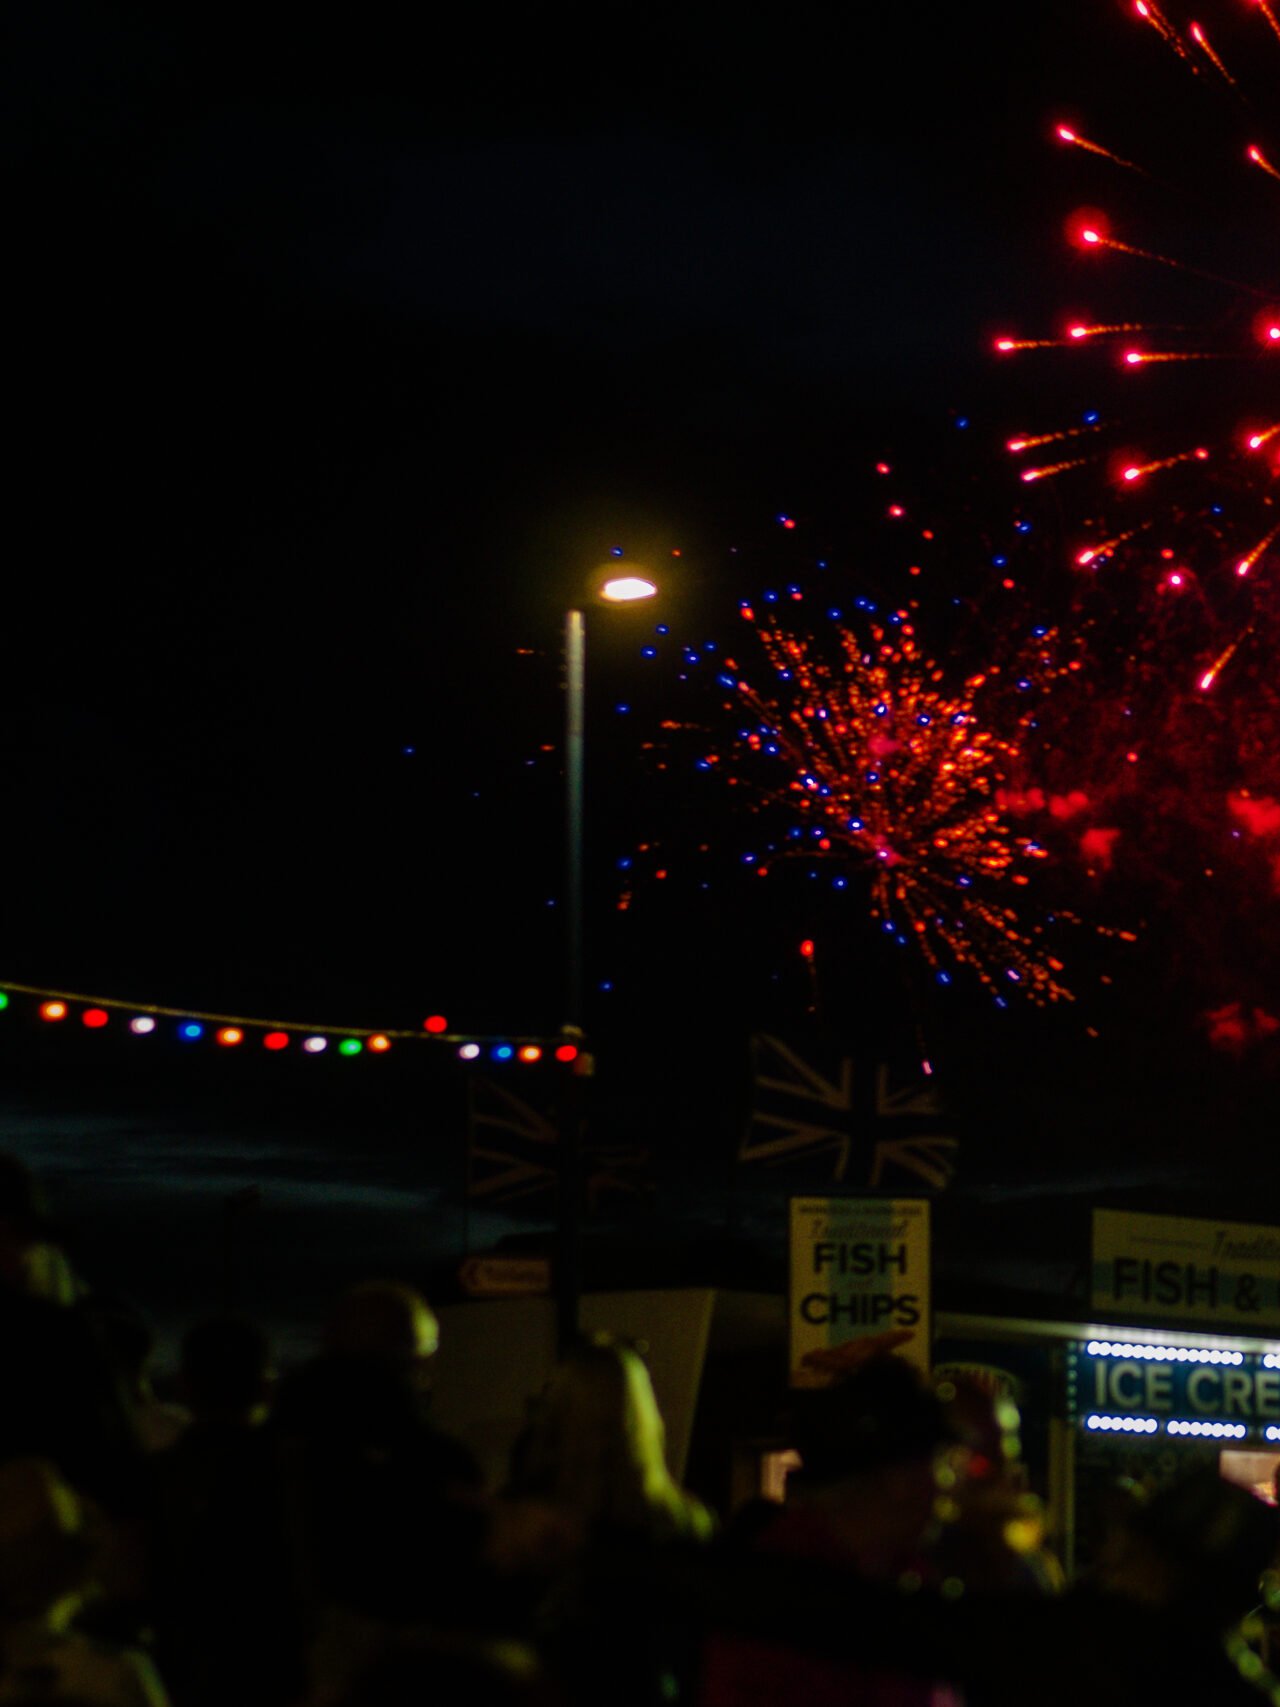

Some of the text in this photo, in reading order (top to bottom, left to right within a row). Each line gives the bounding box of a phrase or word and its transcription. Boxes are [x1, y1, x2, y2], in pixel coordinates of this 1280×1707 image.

[814, 1243, 906, 1274] FISH
[1113, 1258, 1217, 1308] FISH
[1235, 1274, 1261, 1313] &
[801, 1293, 920, 1325] CHIPS
[1094, 1360, 1173, 1411] ICE
